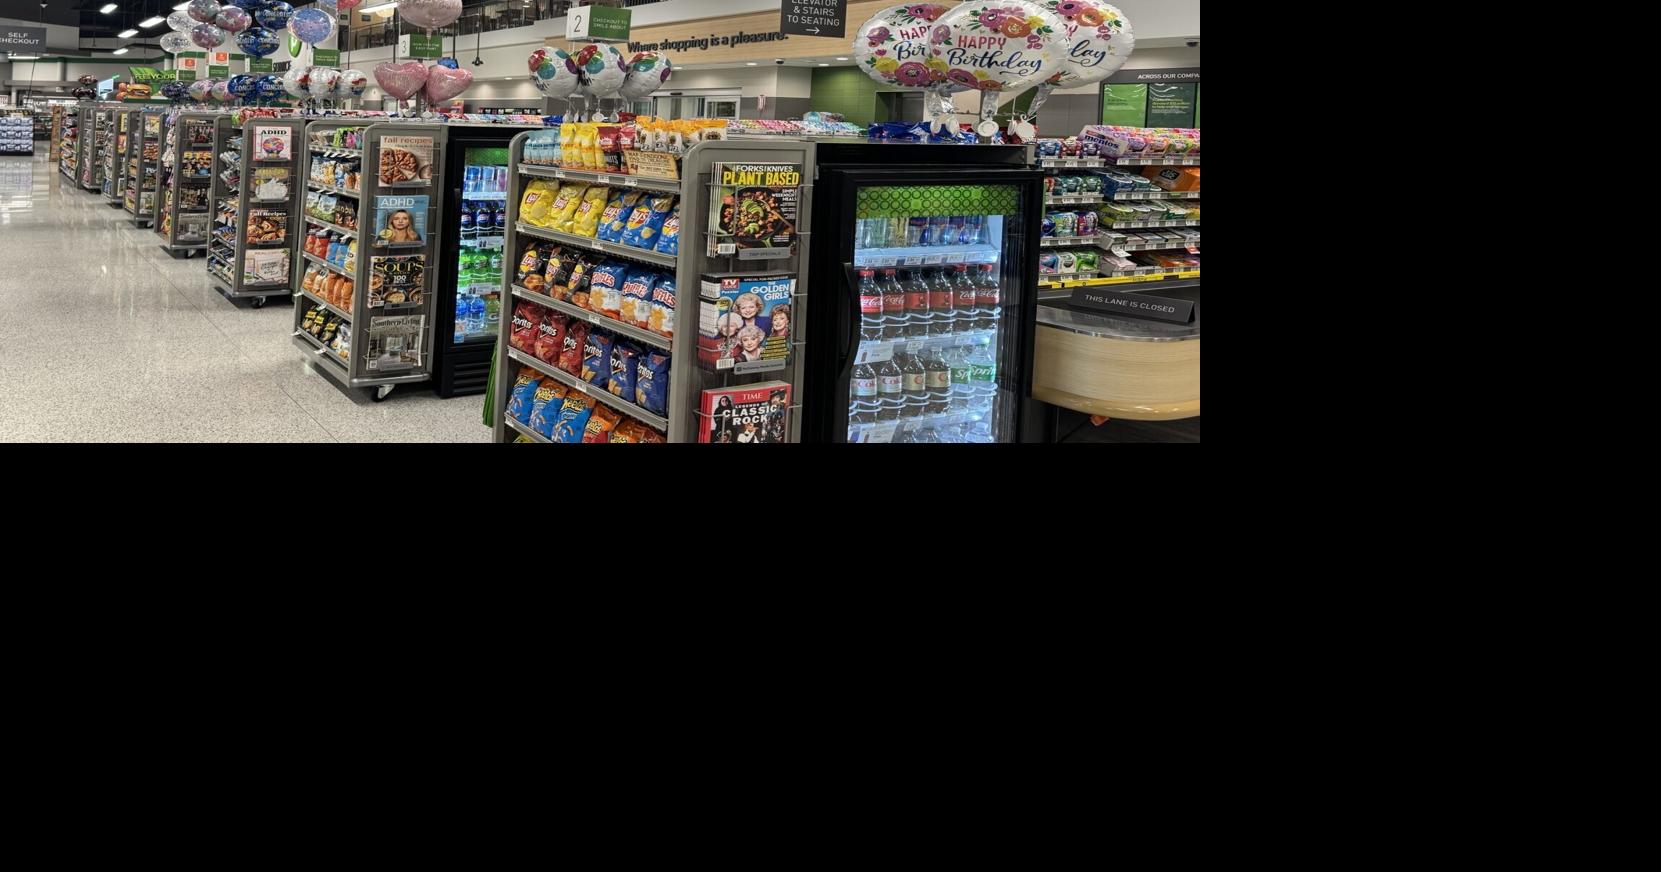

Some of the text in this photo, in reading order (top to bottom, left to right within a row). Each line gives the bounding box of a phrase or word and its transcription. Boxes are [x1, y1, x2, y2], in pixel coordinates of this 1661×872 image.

[803, 7, 834, 16] STAIRS
[574, 15, 582, 32] 2
[787, 15, 840, 26] TO SEATING
[402, 40, 407, 53] 3
[627, 31, 788, 53] Where shopping is a pleasure.
[958, 35, 1006, 50] HAPPY
[947, 47, 1042, 76] Birthday
[1085, 135, 1119, 150] mentos
[723, 171, 800, 186] PLANT BASED
[381, 198, 415, 206] ADHD
[375, 262, 424, 271] SOUPS
[751, 284, 790, 294] GOLDEN
[764, 291, 789, 301] GIRLS
[1085, 294, 1103, 303] THIS
[1105, 297, 1128, 306] LANE
[1139, 302, 1175, 313] CLOSED
[372, 319, 402, 327] Southern
[723, 404, 777, 418] CLASSIC
[732, 414, 767, 426] ROCK
